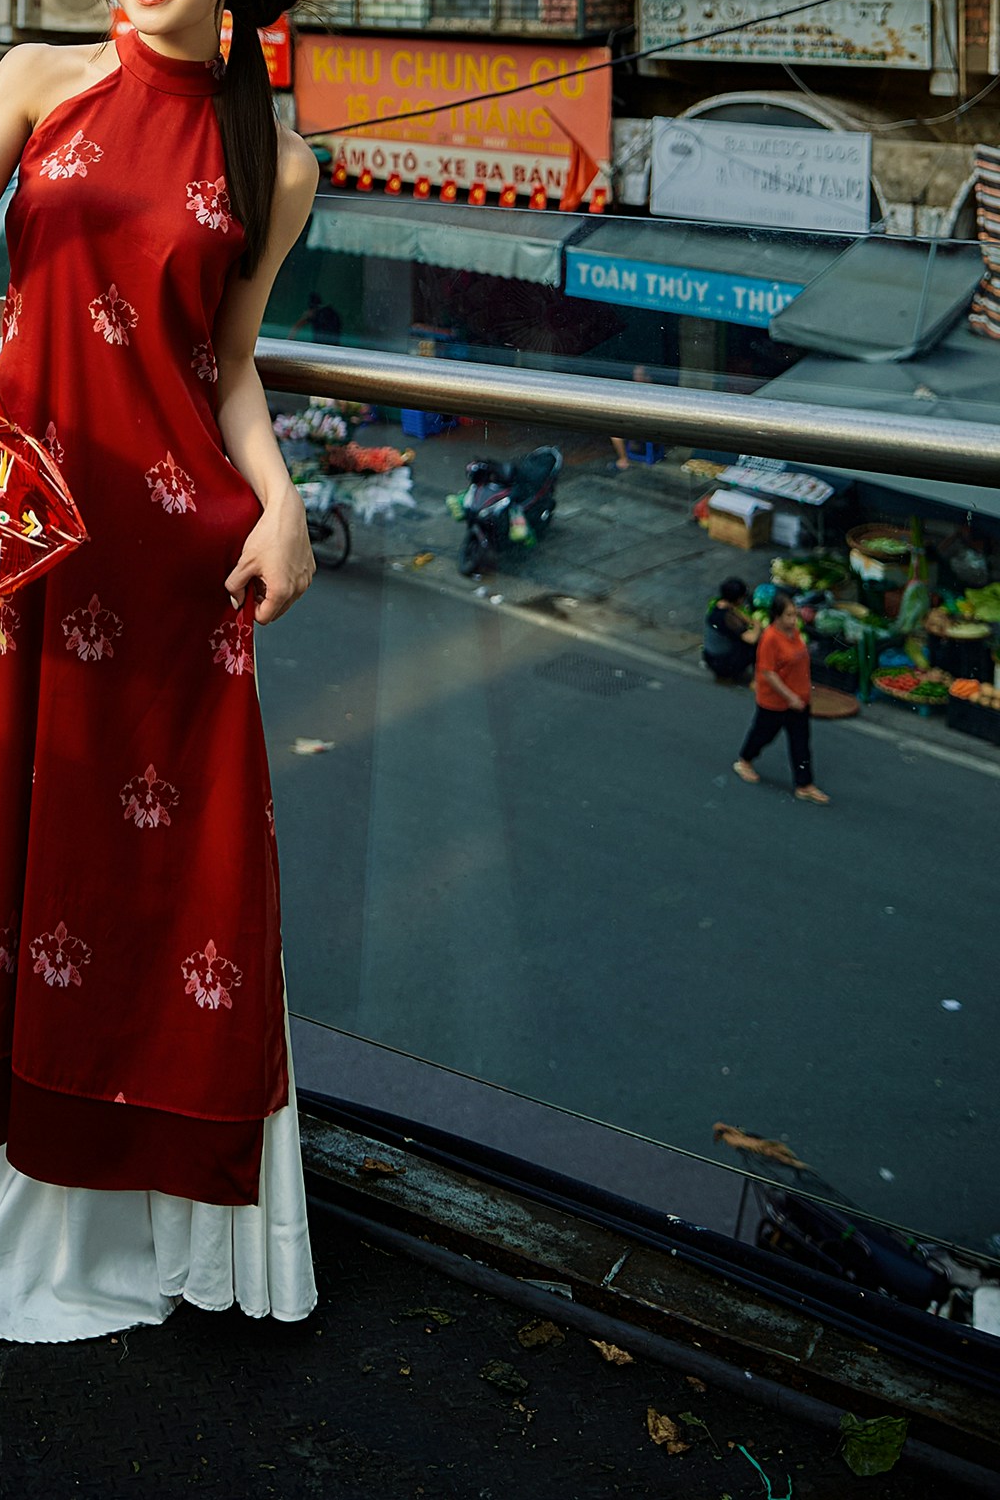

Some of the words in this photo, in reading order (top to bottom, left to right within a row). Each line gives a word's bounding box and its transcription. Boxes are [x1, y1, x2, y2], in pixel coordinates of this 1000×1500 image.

[312, 46, 381, 86] KHU
[391, 49, 518, 93] CHUNG
[376, 95, 437, 128] CAO
[372, 145, 386, 169] Ô
[437, 157, 466, 179] XE
[475, 161, 505, 182] BA
[513, 158, 566, 188] BÁN
